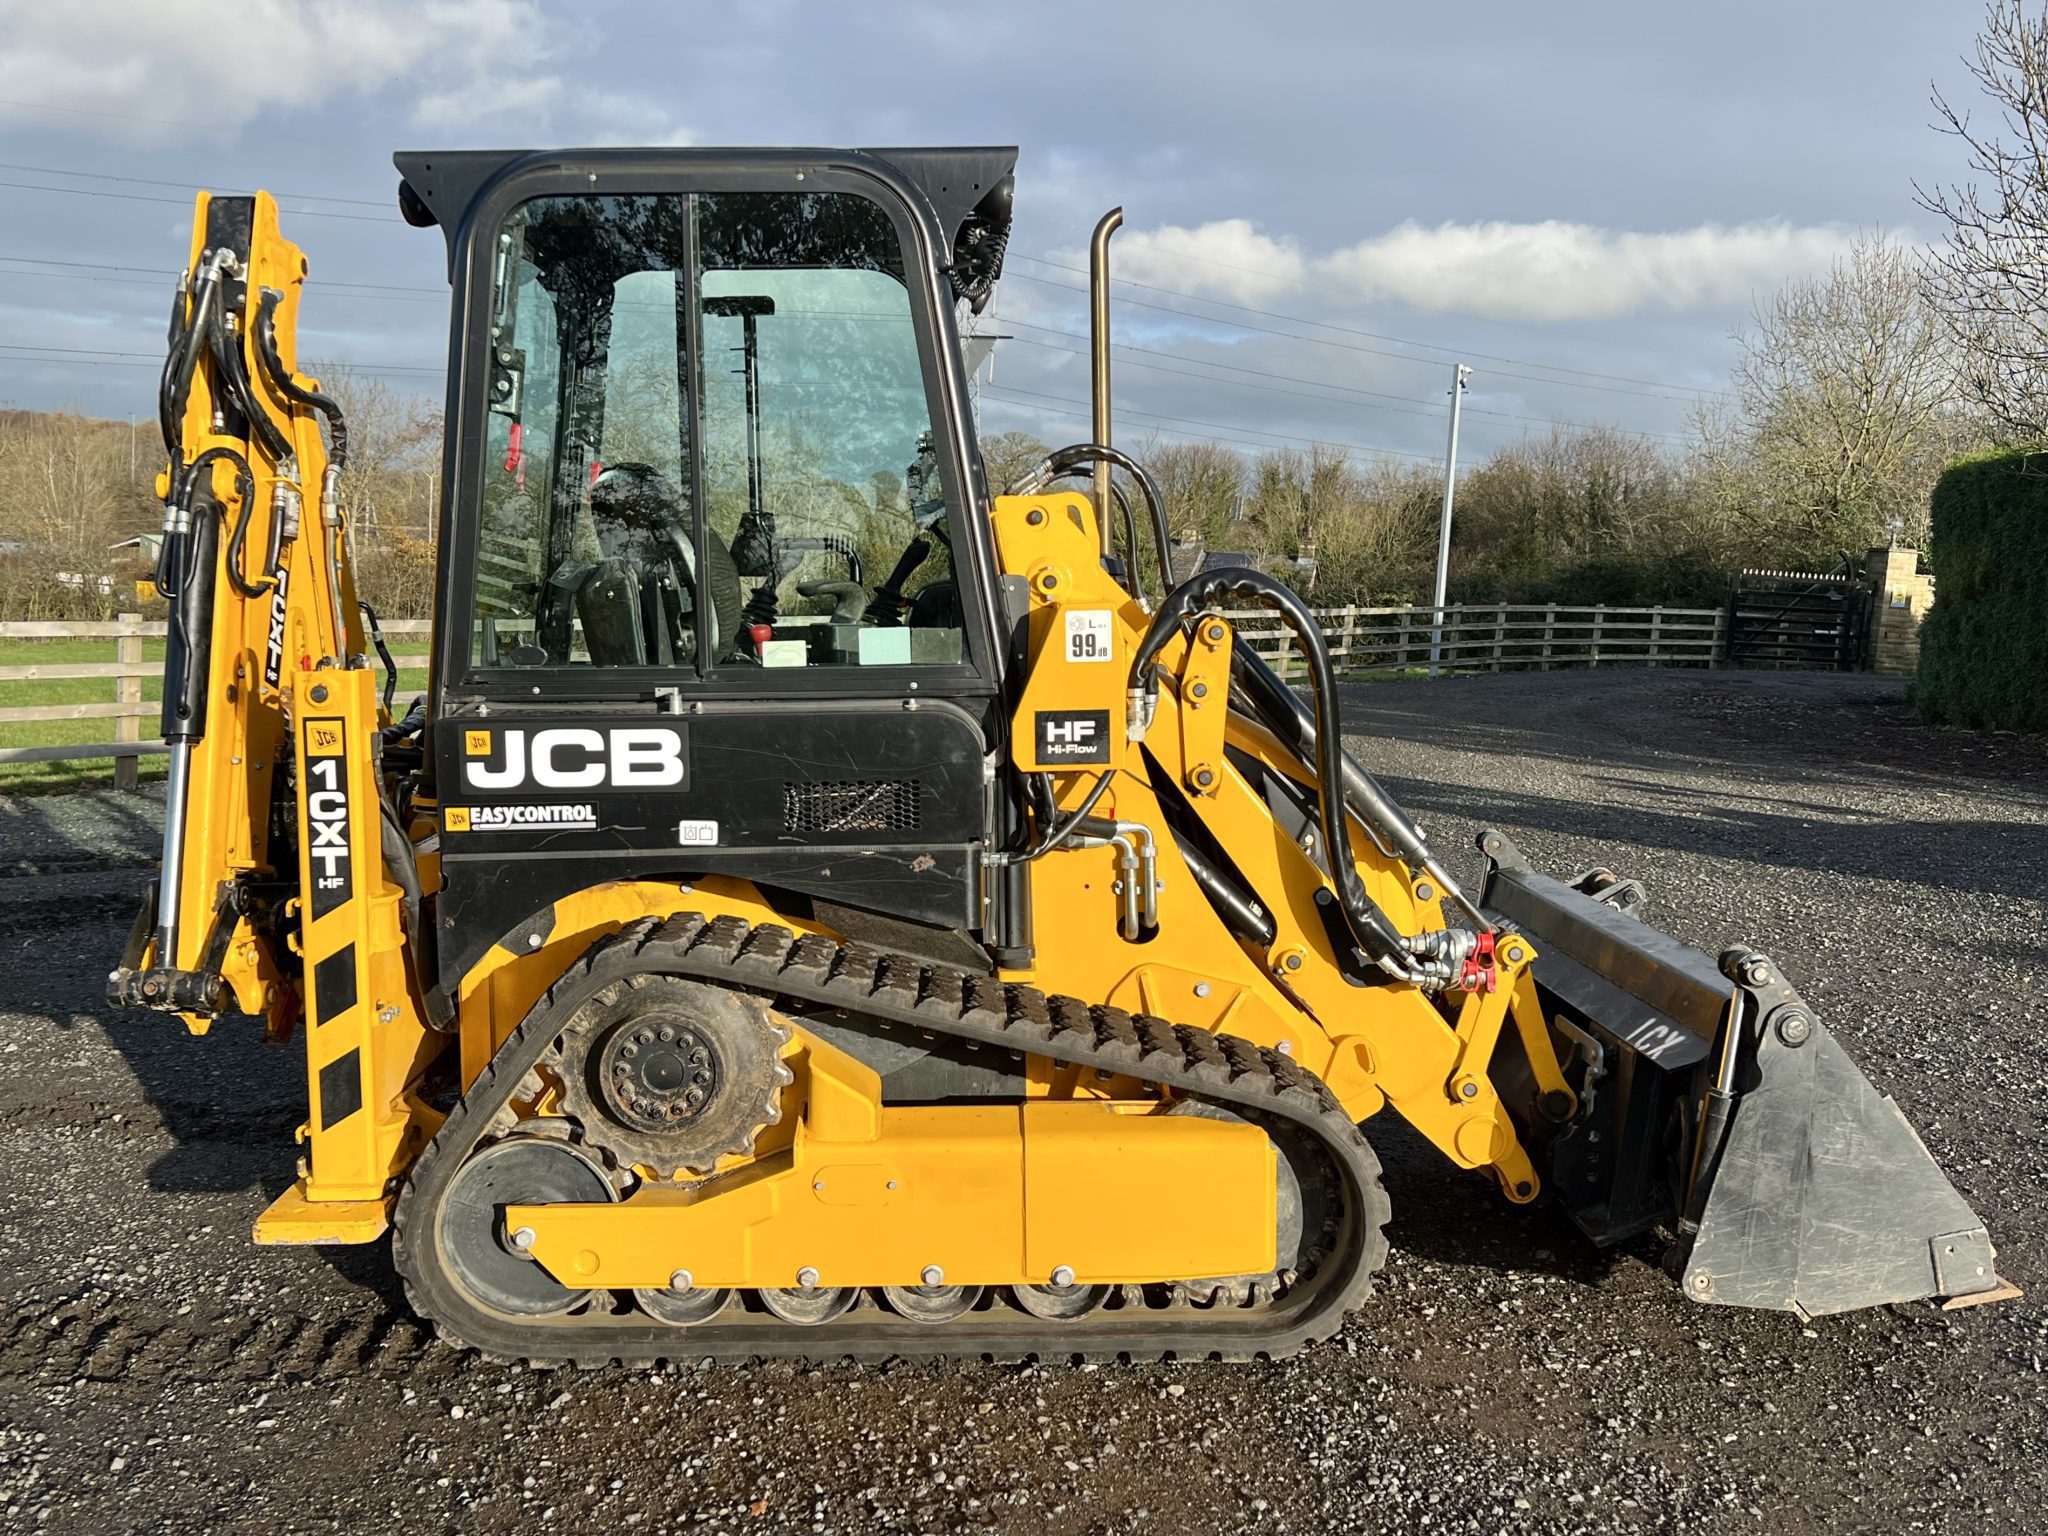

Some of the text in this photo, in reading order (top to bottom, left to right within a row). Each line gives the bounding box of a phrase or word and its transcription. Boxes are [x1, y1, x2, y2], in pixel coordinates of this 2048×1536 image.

[1072, 633, 1096, 657] 99
[316, 730, 337, 746] JCB
[1047, 720, 1096, 742] HF
[466, 728, 684, 789] JCB
[1047, 744, 1098, 754] Hi-Flow
[309, 759, 349, 889] 1CXT HF
